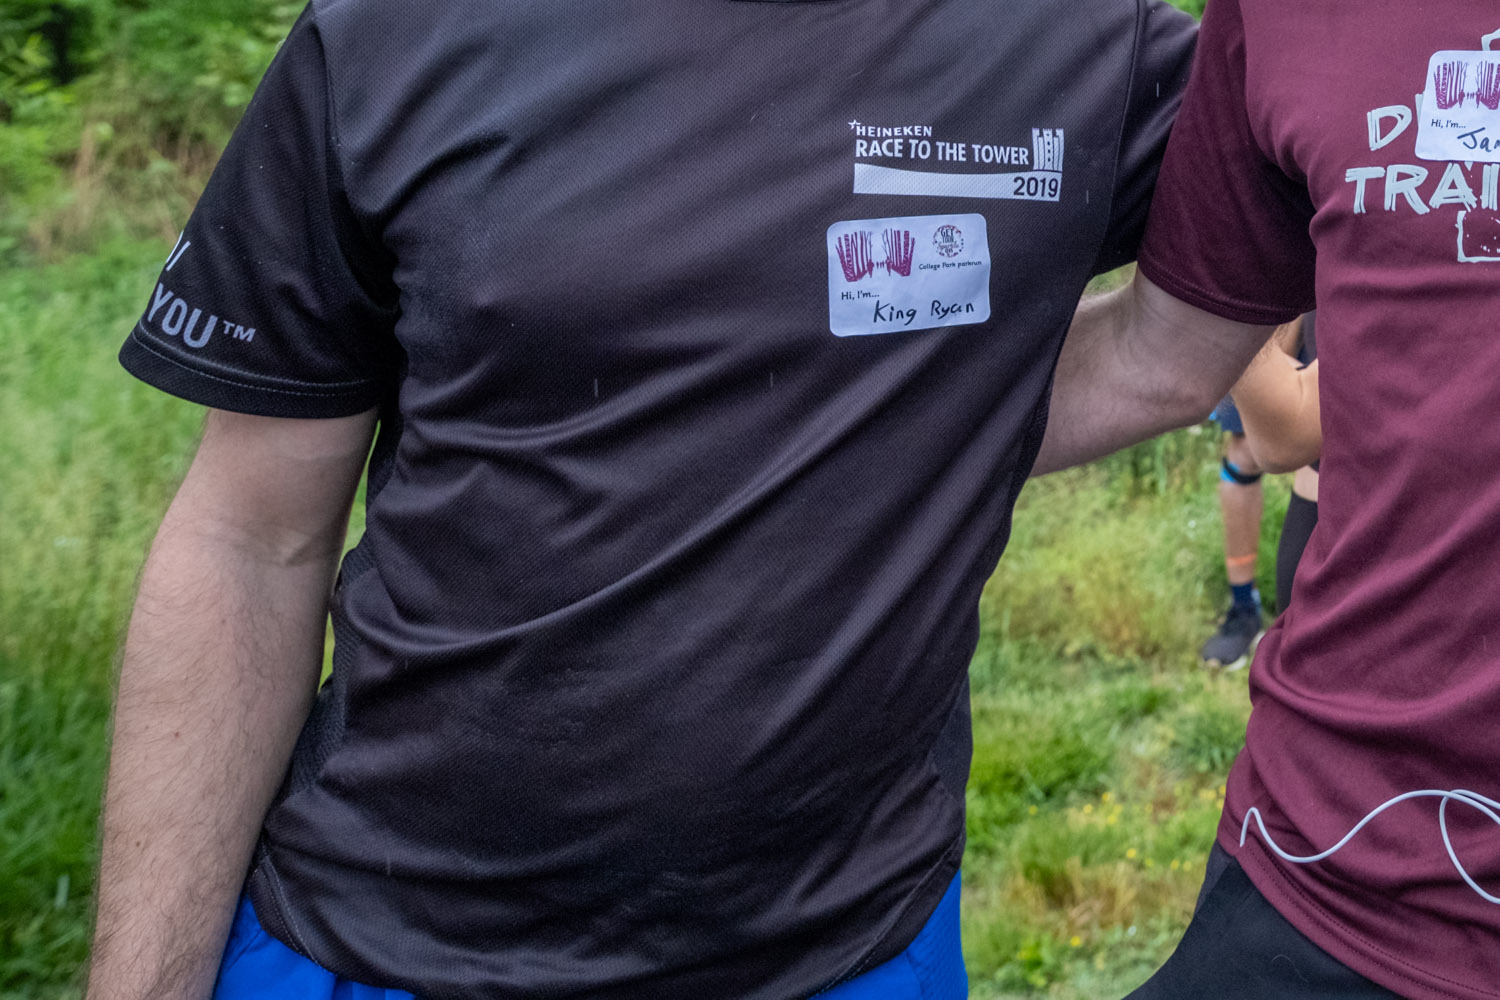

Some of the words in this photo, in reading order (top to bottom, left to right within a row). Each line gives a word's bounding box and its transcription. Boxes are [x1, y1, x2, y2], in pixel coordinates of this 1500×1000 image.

[1431, 119, 1444, 129] Hi,
[1445, 120, 1466, 129] I'm...
[855, 126, 933, 137] HEINEKEN
[855, 139, 904, 158] RACE
[909, 139, 931, 159] TO
[936, 142, 967, 162] THE
[972, 144, 1029, 165] TOWER
[1013, 176, 1059, 198] 2019
[940, 229, 953, 237] GET
[957, 260, 982, 269] parkrun
[841, 291, 855, 300] Hi,
[857, 290, 880, 299] I'm...
[873, 300, 917, 326] King
[930, 300, 974, 320] Ryan
